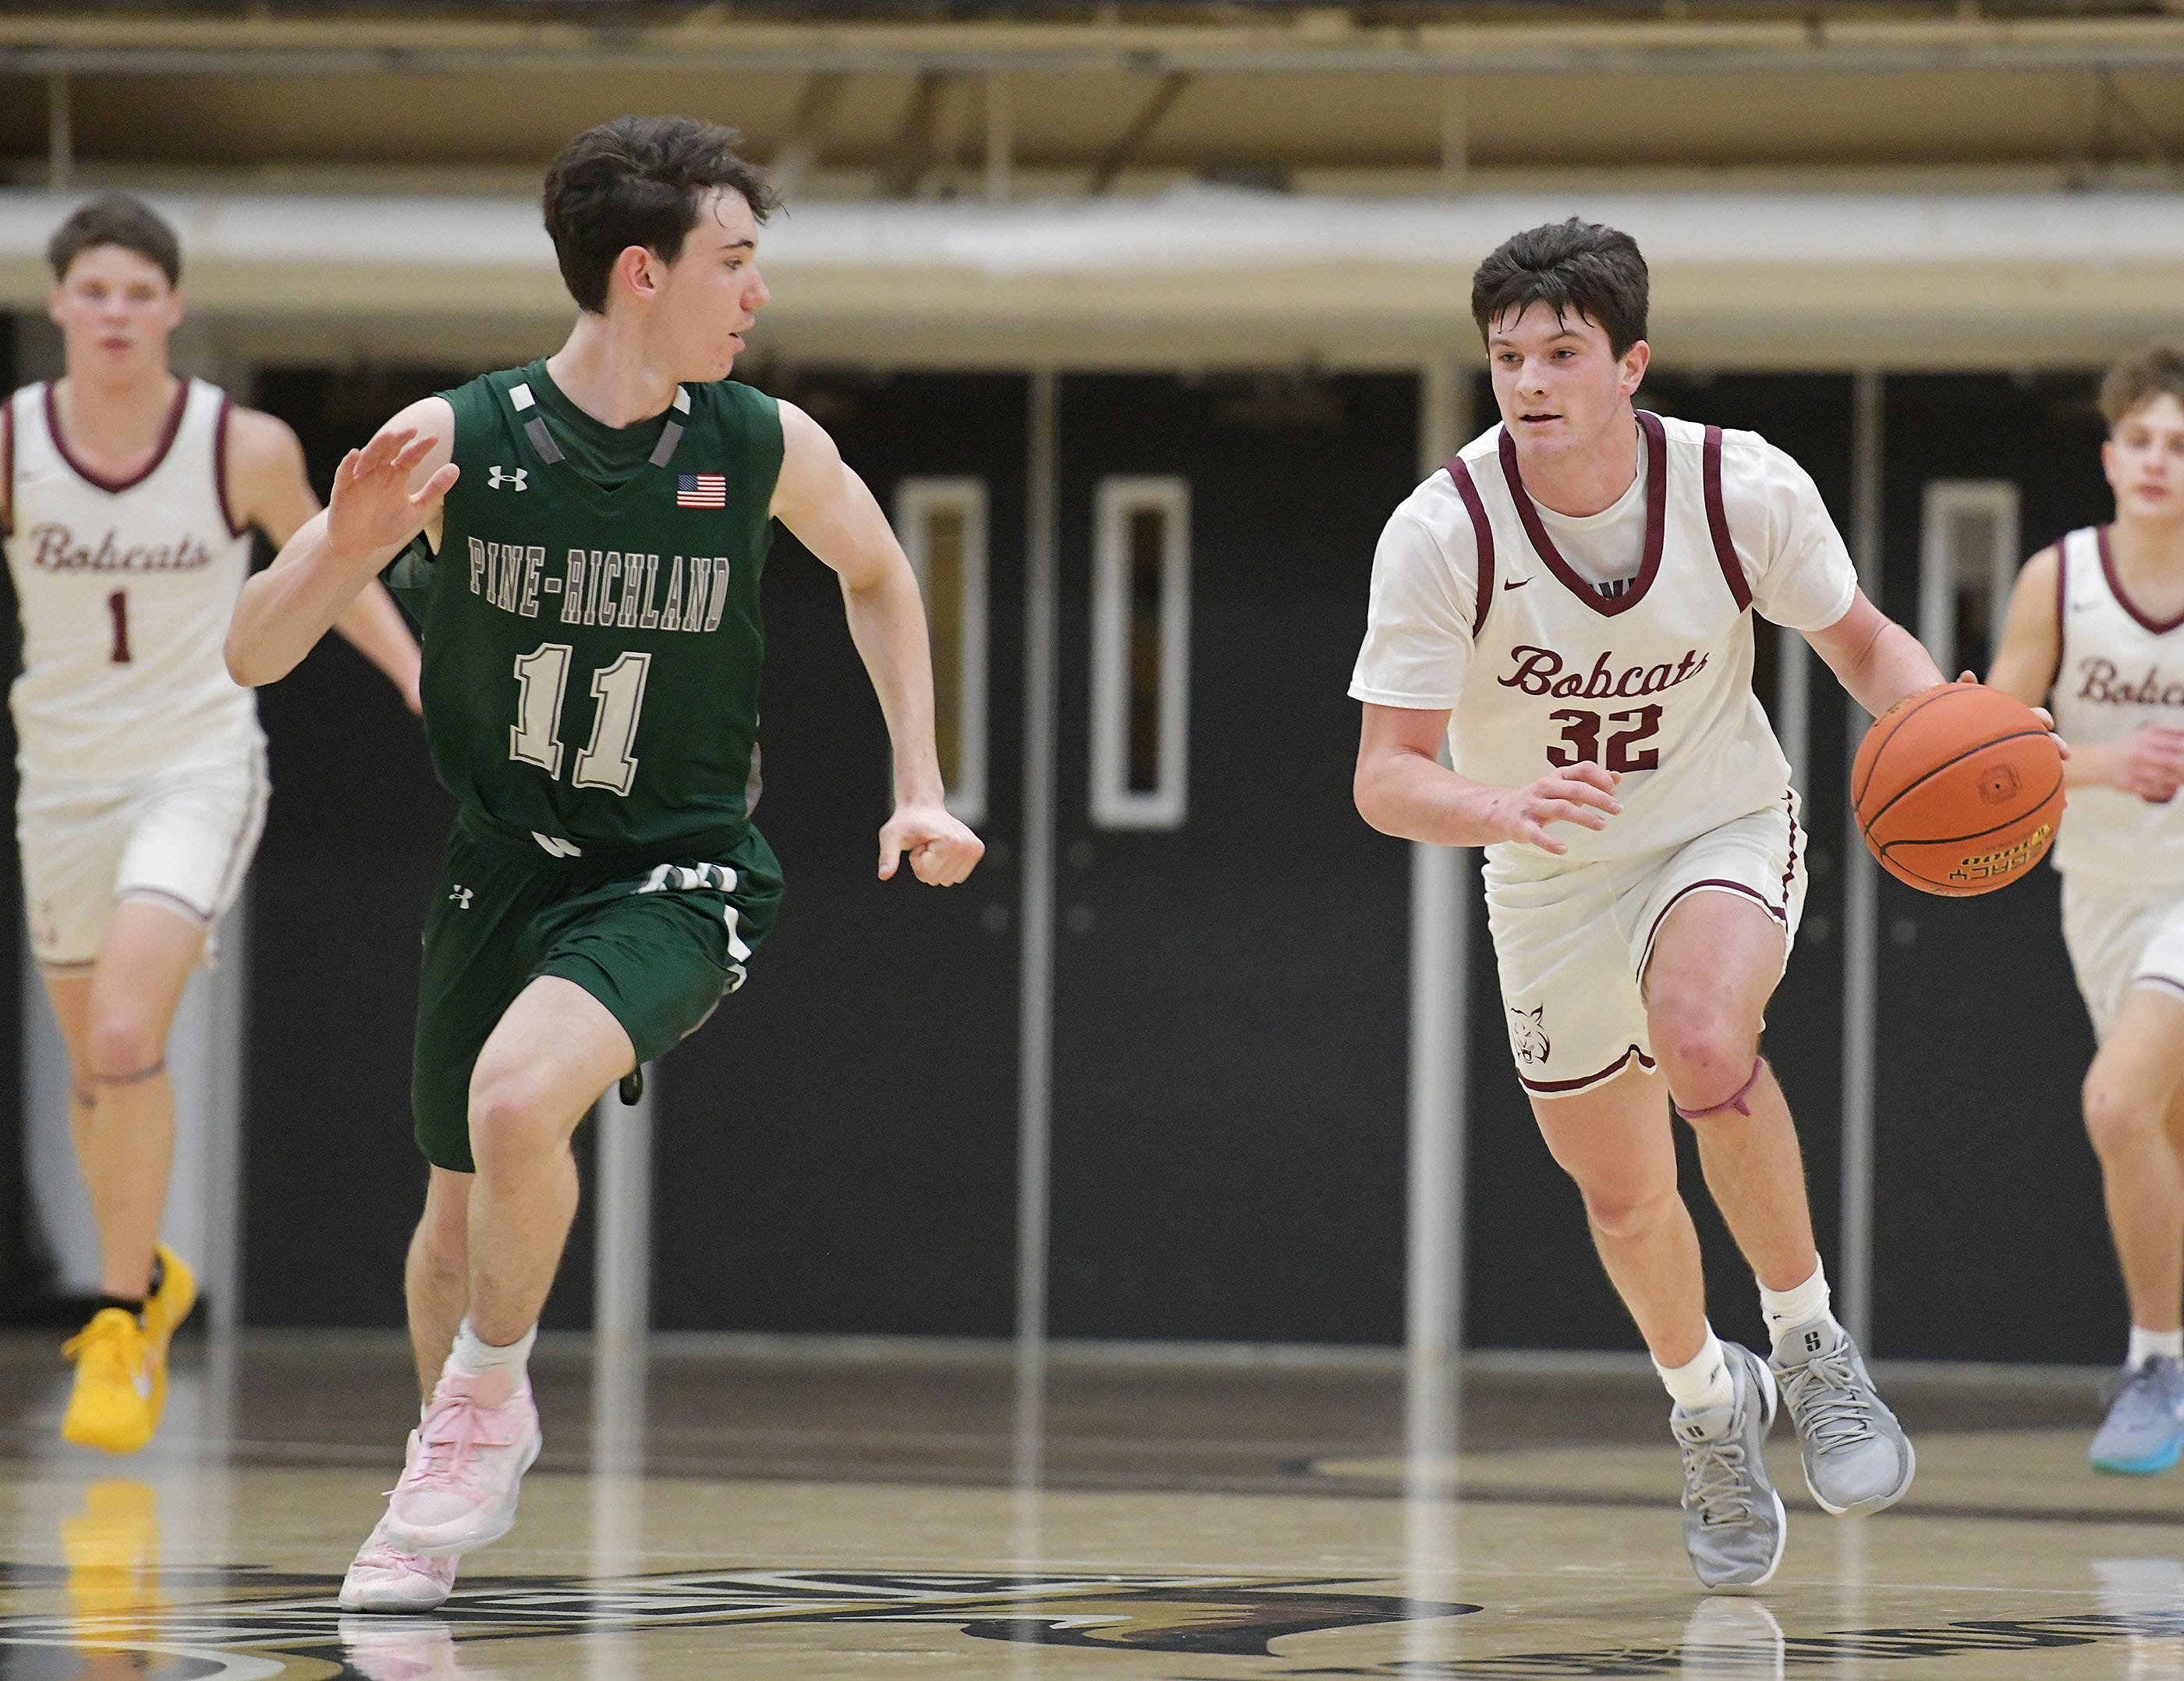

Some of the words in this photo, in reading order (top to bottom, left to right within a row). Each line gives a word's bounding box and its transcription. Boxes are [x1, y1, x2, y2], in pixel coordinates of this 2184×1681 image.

[31, 523, 210, 573] Bobcats
[467, 536, 729, 633] PINE-RICHLAND
[108, 590, 131, 663] 1
[509, 642, 652, 797] 11
[1547, 704, 1663, 774] 32
